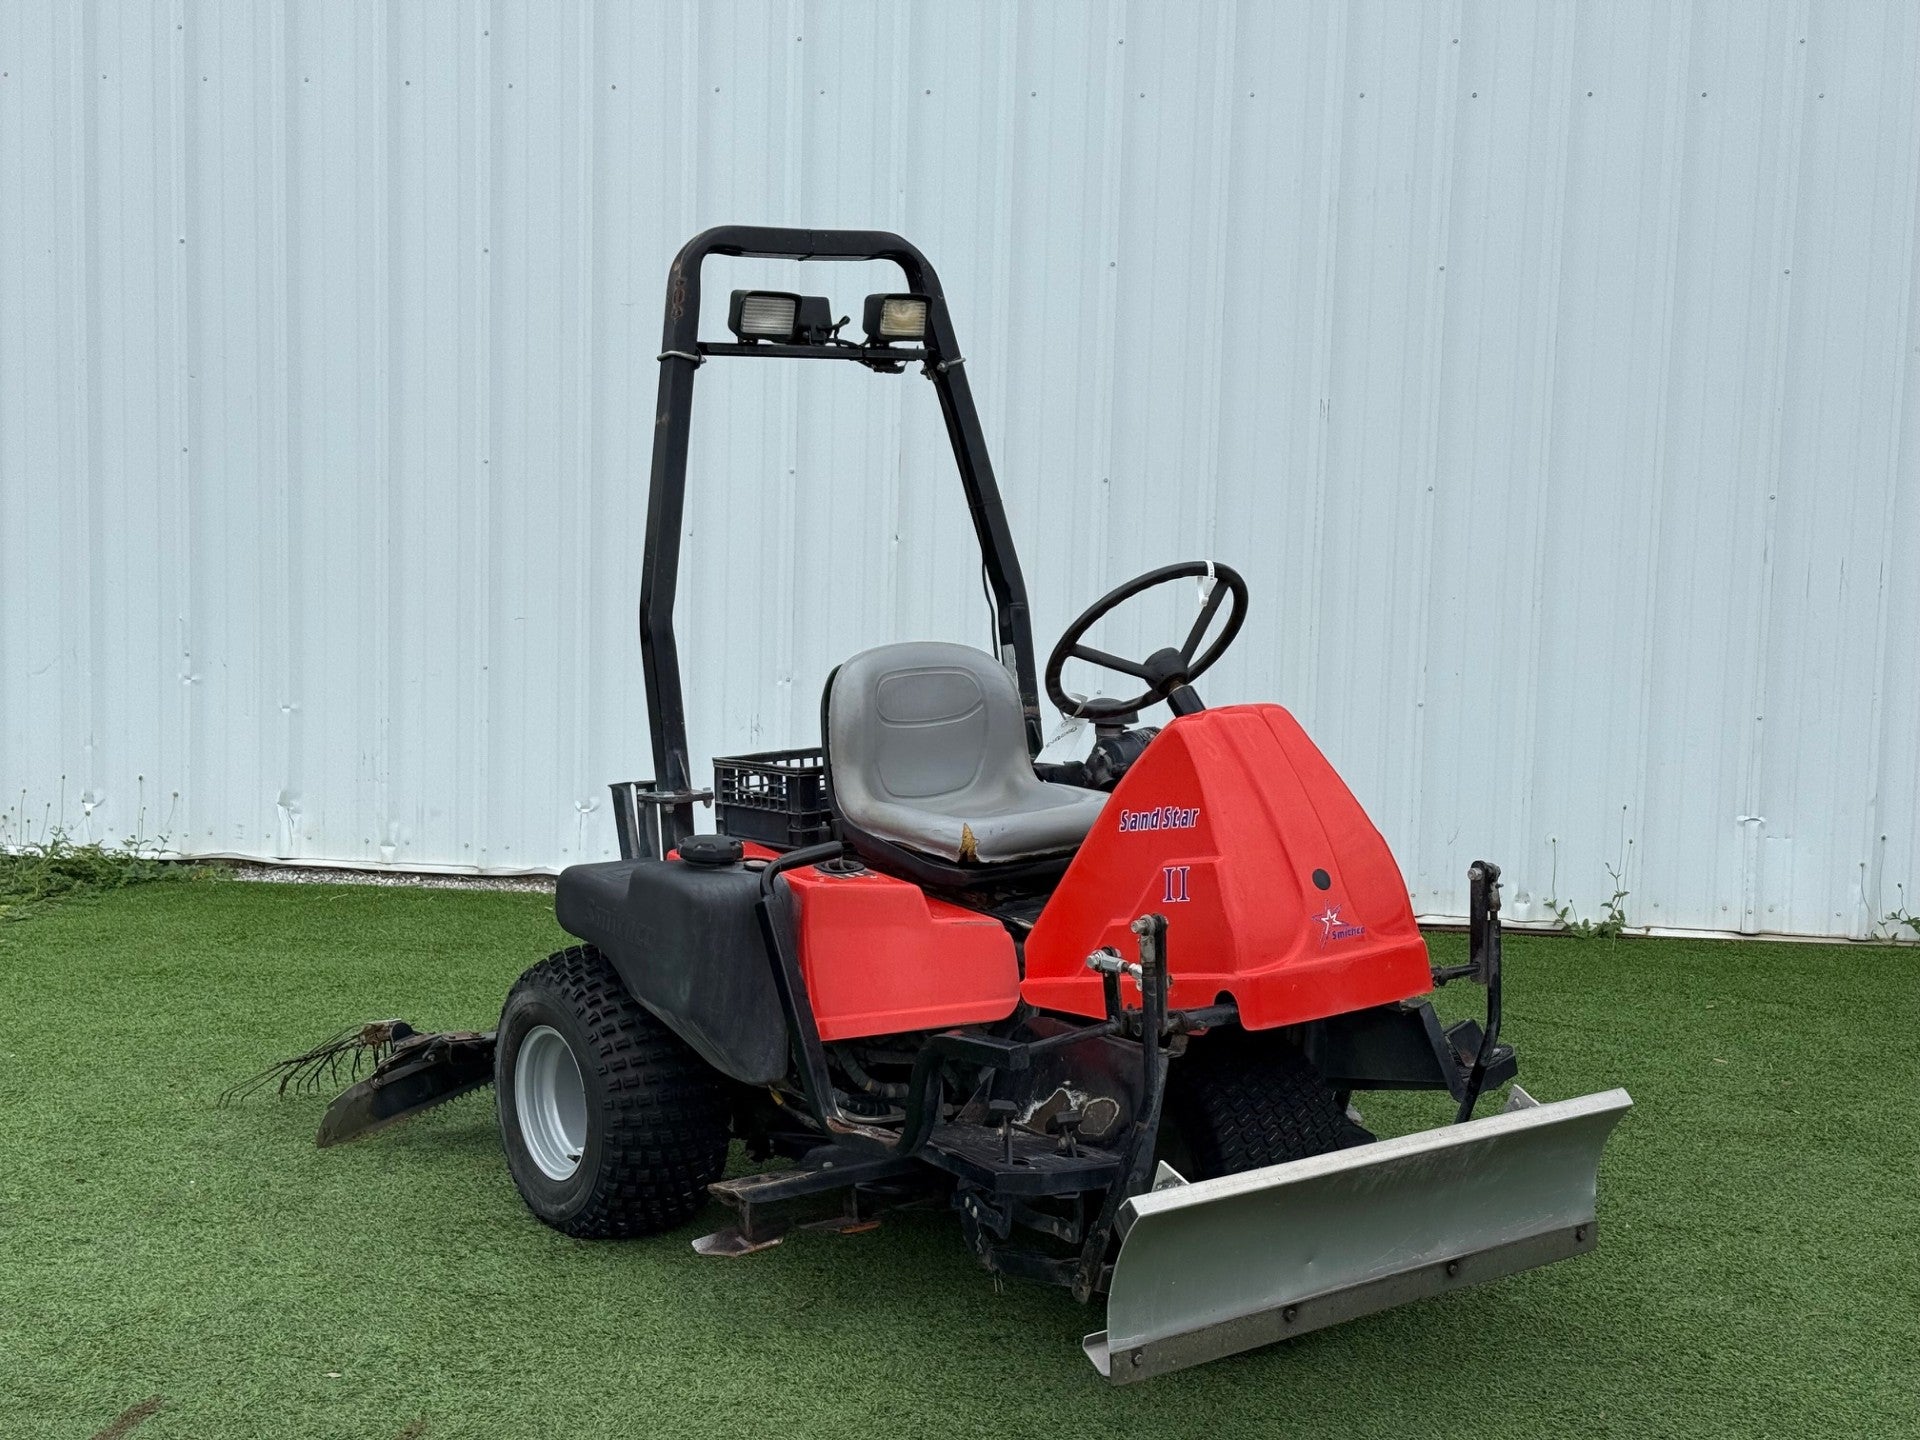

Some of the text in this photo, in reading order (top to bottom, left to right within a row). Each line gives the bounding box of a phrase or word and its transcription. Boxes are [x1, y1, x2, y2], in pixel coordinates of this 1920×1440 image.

[1119, 806, 1200, 832] Sand Star
[1162, 866, 1190, 902] II
[1331, 926, 1365, 940] Smithco
